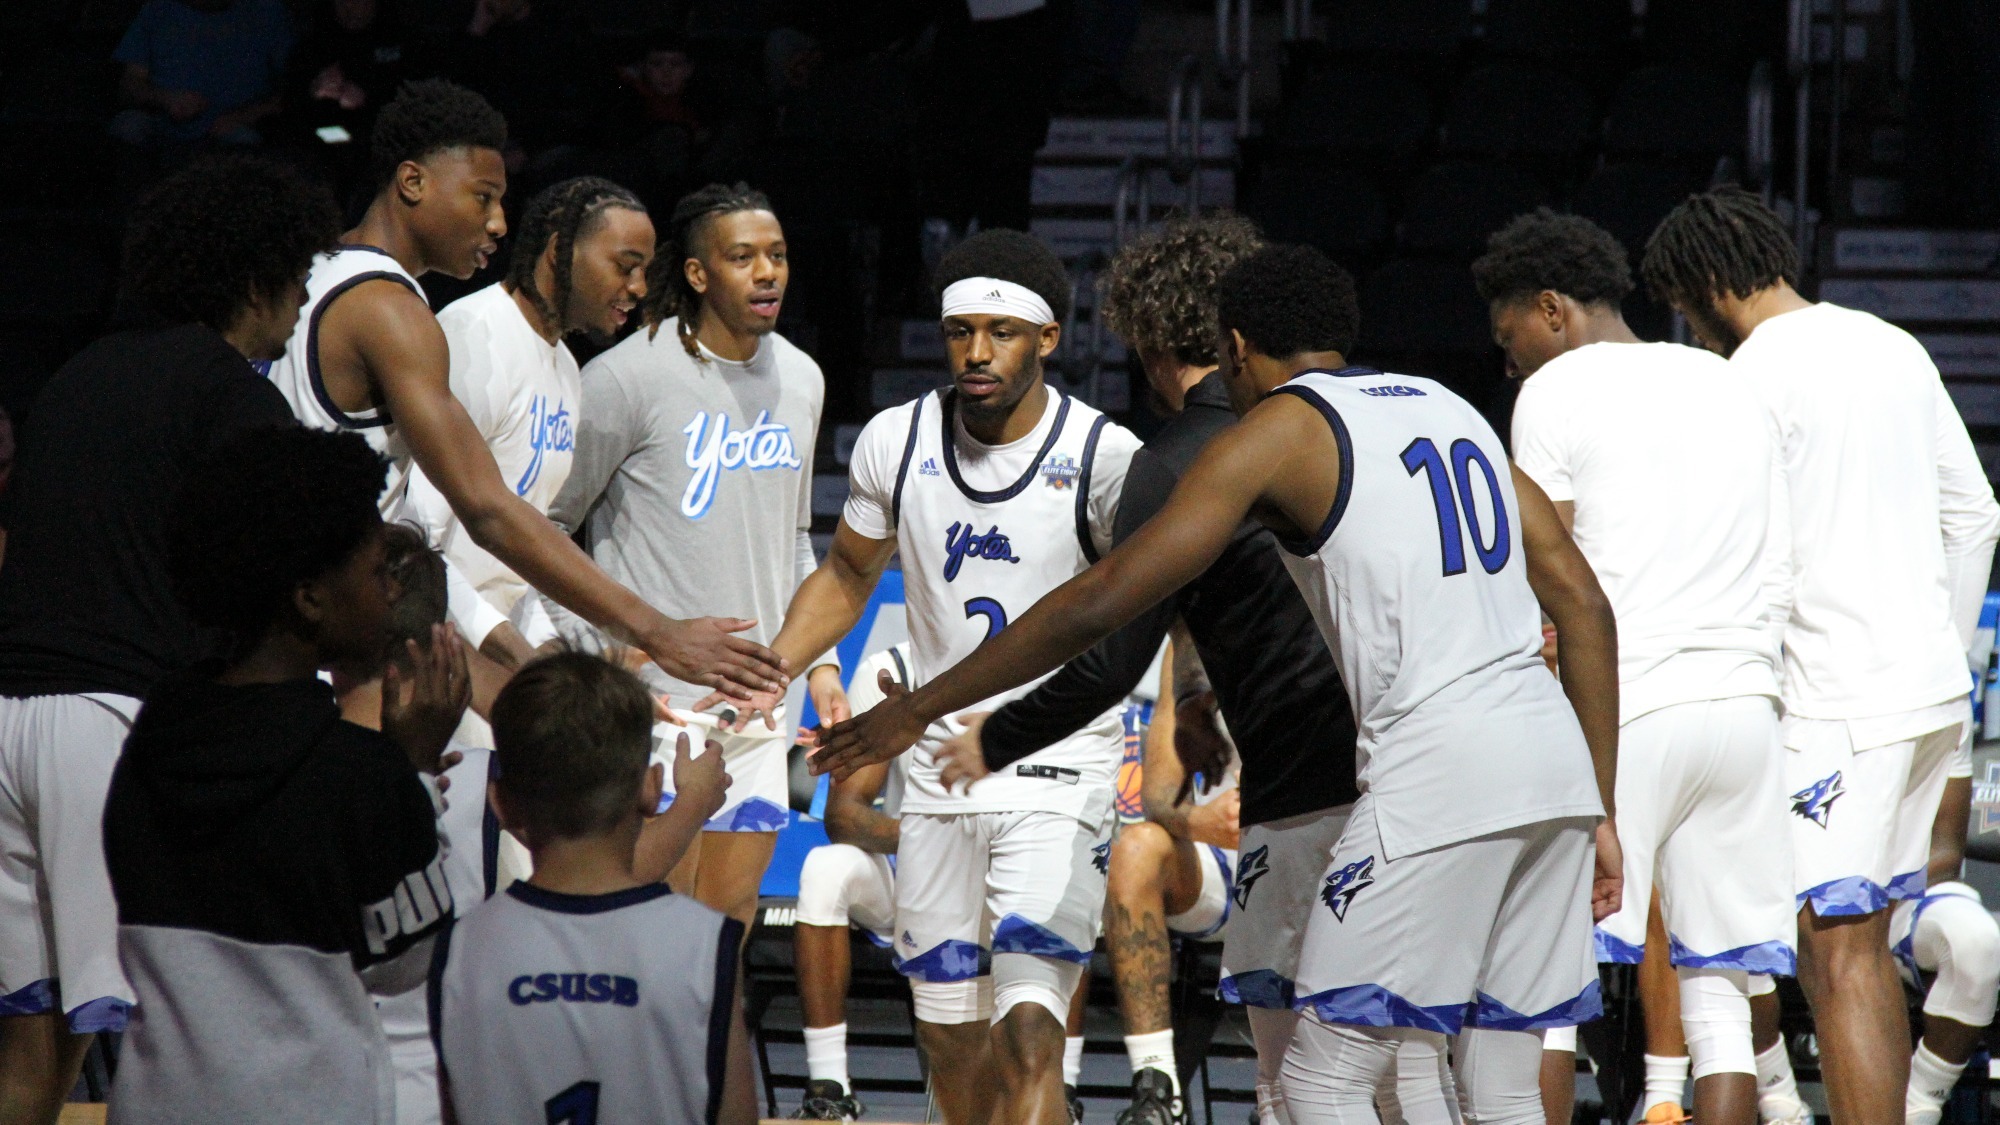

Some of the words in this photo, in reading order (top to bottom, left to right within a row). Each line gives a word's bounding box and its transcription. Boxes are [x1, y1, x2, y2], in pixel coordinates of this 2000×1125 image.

[681, 409, 801, 519] Yotes
[1399, 437, 1510, 577] 10
[943, 521, 1020, 583] Yotes
[507, 972, 639, 1007] CSUSB
